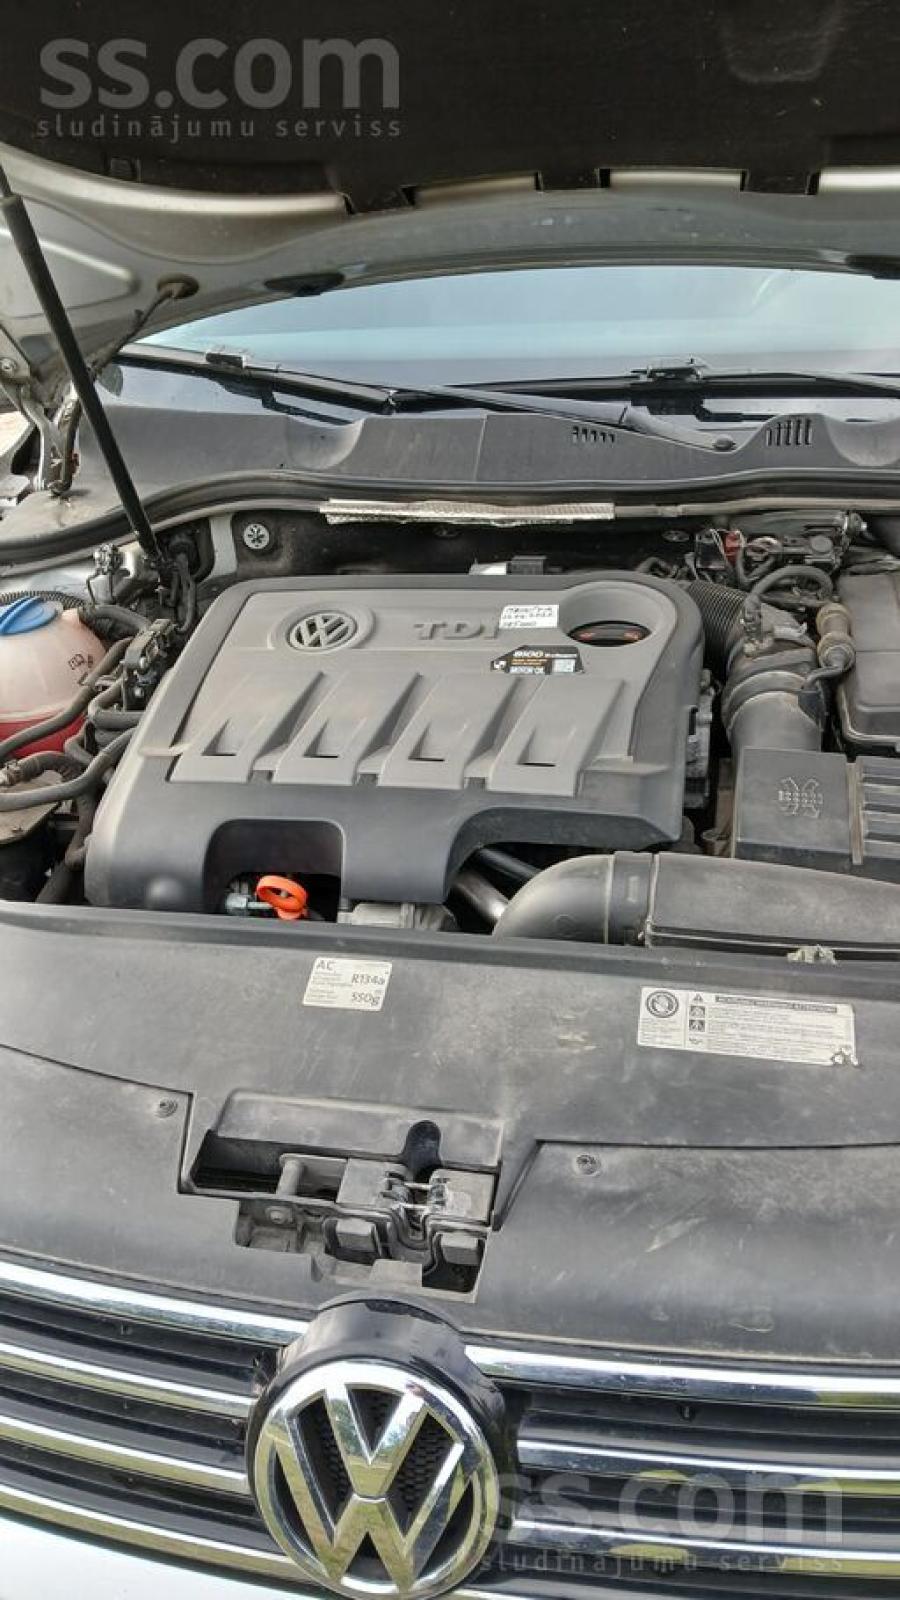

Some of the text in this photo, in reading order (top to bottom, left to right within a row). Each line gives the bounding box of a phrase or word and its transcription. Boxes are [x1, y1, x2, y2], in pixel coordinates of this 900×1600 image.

[413, 622, 499, 641] TDI
[316, 959, 337, 971] AC
[351, 973, 386, 986] R134a
